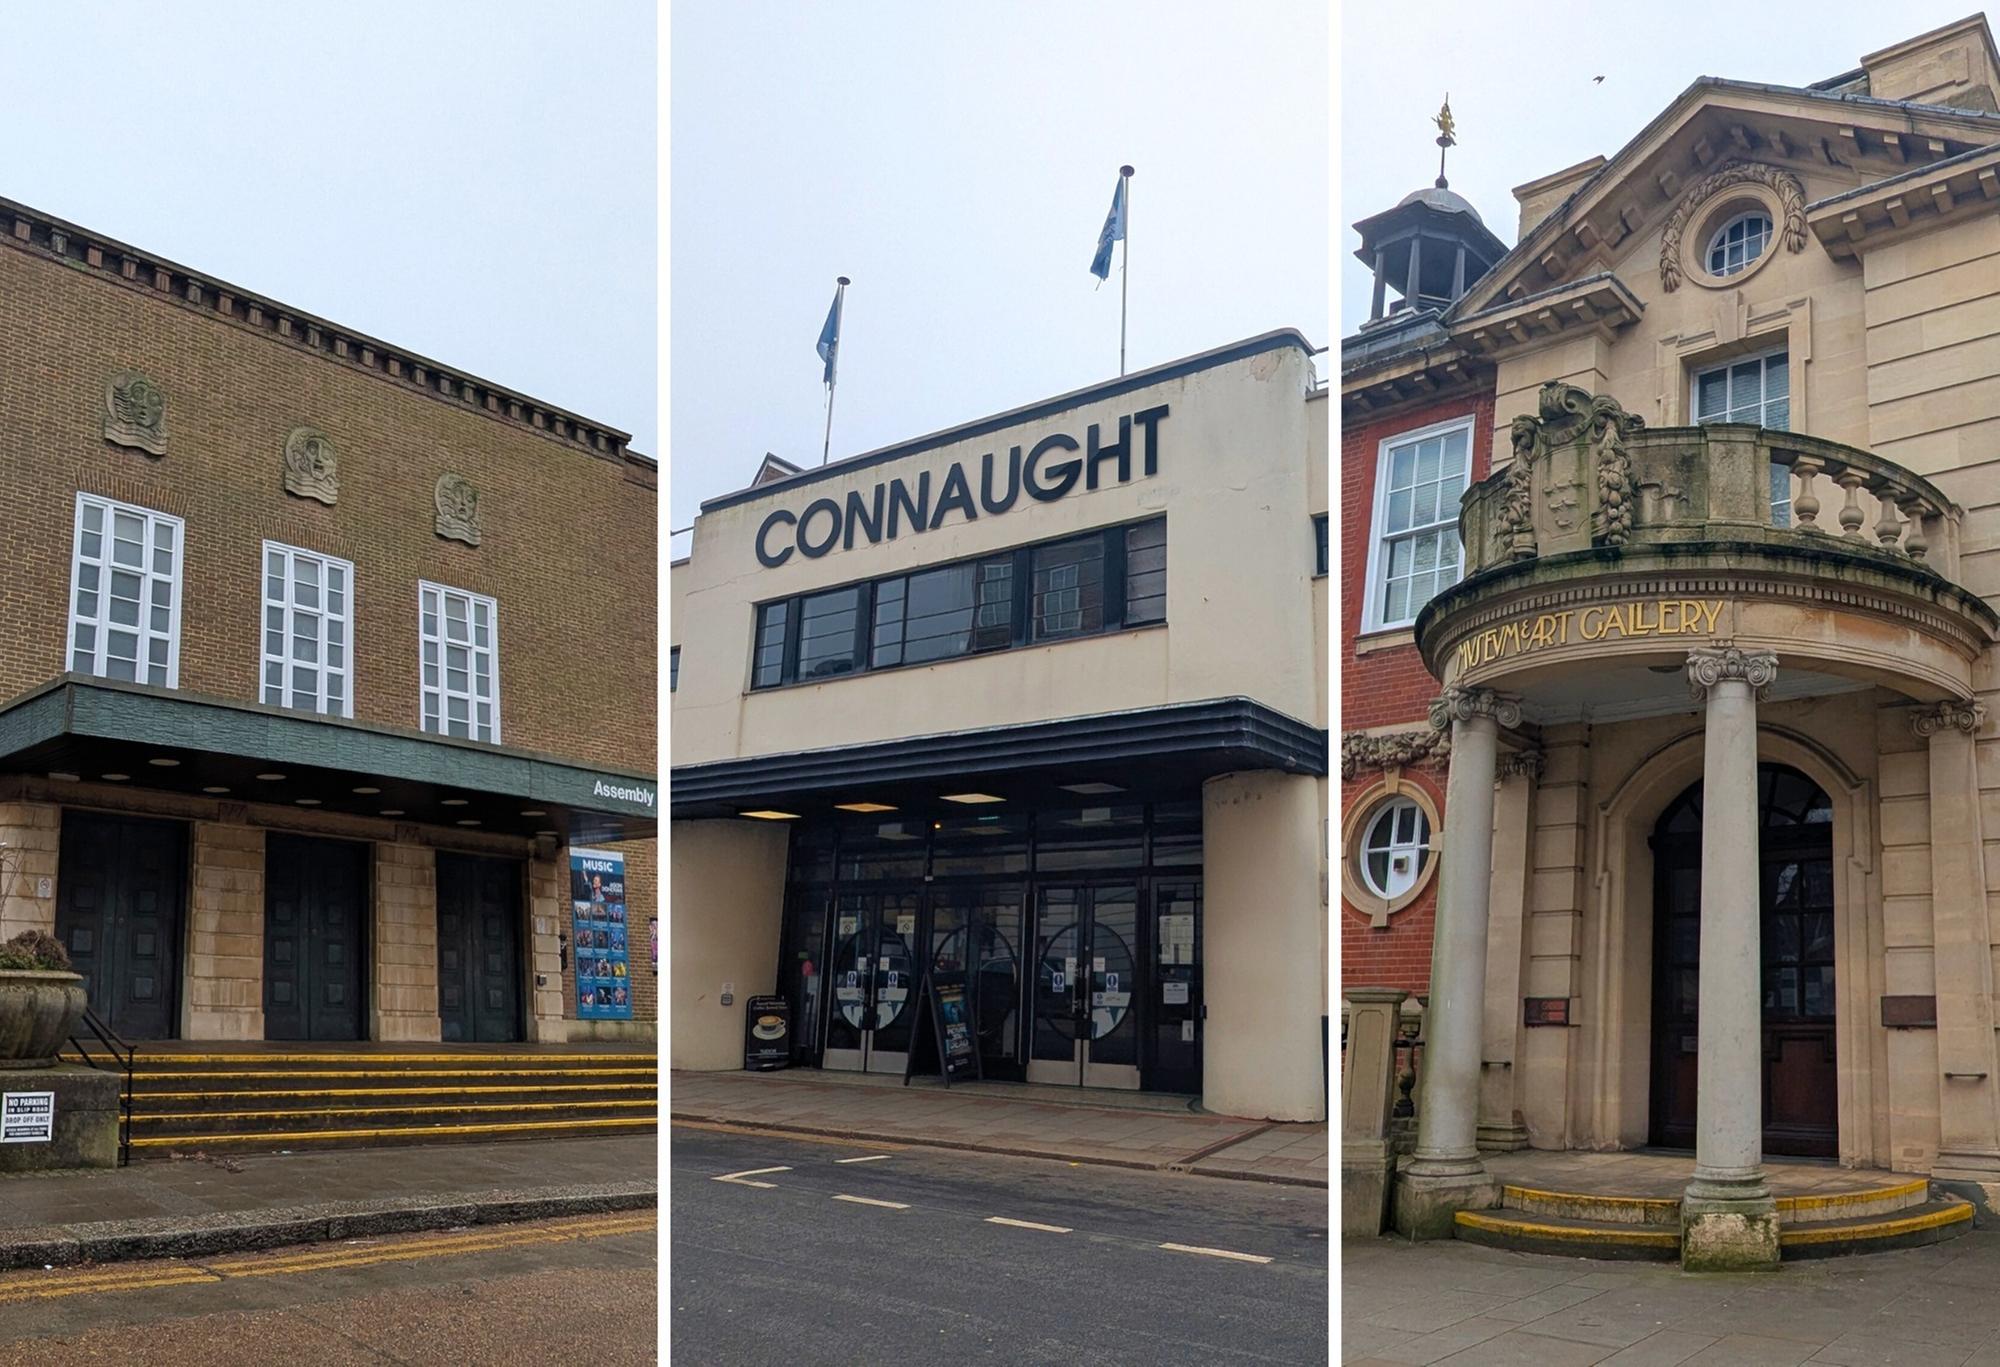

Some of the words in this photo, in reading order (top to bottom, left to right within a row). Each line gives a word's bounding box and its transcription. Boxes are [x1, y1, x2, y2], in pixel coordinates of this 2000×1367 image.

[755, 404, 1170, 569] CONNAUGHT
[1526, 611, 1576, 651] ART
[1580, 600, 1724, 640] GALLERY
[593, 780, 654, 807] Assembly
[582, 859, 614, 873] MUSIC
[8, 1098, 19, 1106] NO
[20, 1098, 48, 1106] PARKING
